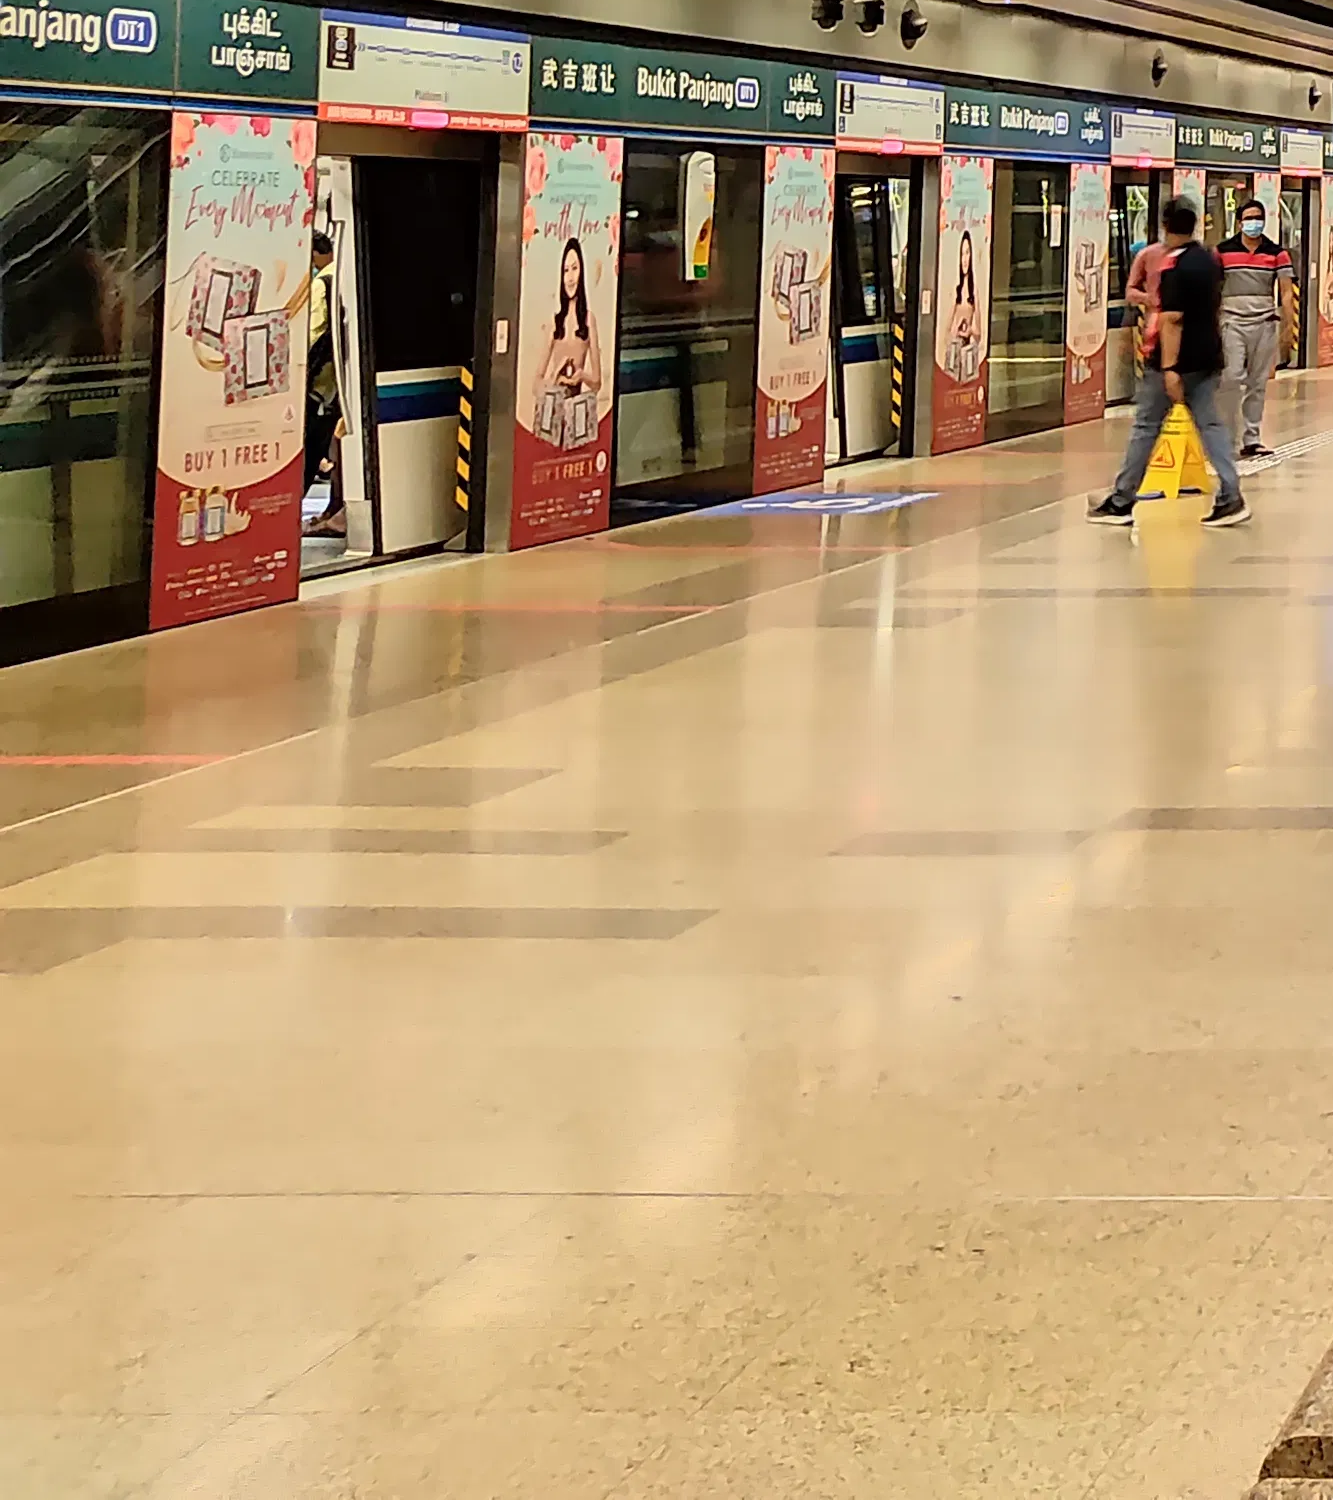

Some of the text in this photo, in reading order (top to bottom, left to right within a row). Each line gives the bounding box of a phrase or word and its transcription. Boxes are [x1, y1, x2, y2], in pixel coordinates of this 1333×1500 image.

[117, 19, 146, 42] DT1
[541, 58, 615, 94] 武吉班让
[637, 67, 676, 98] Bukit
[678, 72, 734, 109] Panjang
[211, 169, 281, 188] CELEBRATE
[184, 183, 300, 239] Every Moment
[184, 442, 281, 474] BUY 1 FREE 1
[563, 461, 585, 479] FREE
